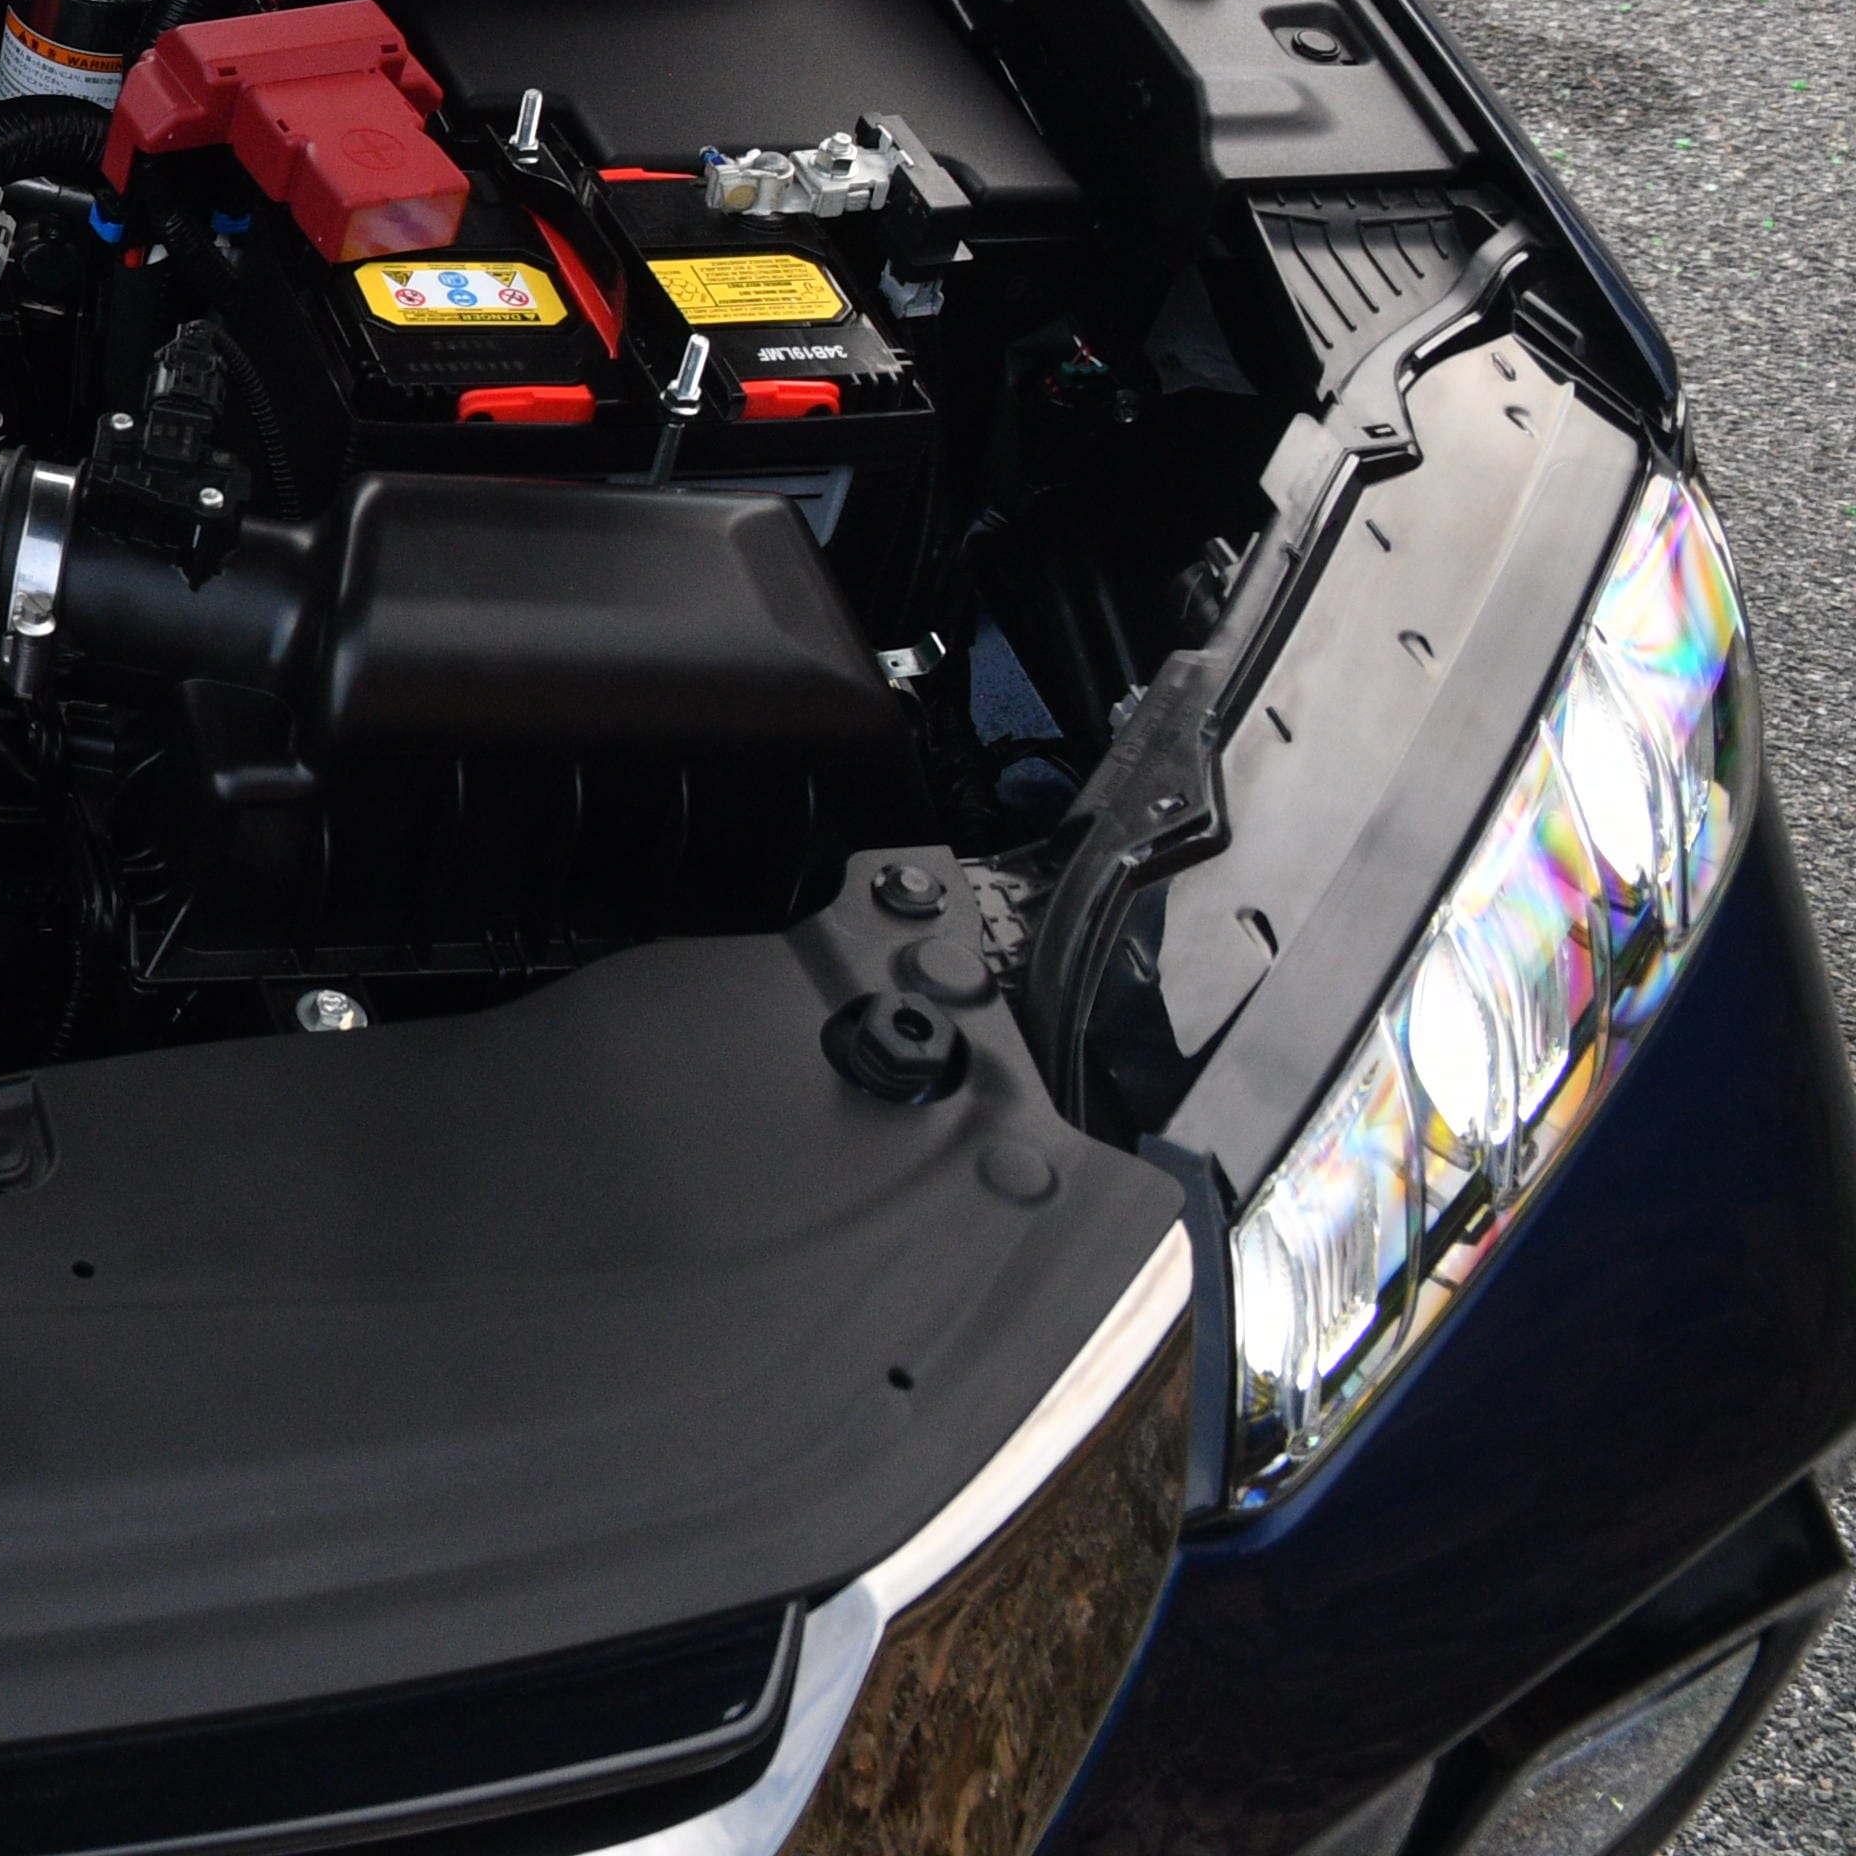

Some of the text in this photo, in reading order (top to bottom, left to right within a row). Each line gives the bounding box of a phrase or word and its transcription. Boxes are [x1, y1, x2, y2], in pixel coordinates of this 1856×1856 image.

[67, 55, 122, 72] WARNIN
[461, 313, 522, 321] DANGER
[757, 345, 848, 362] 34B19LMF
